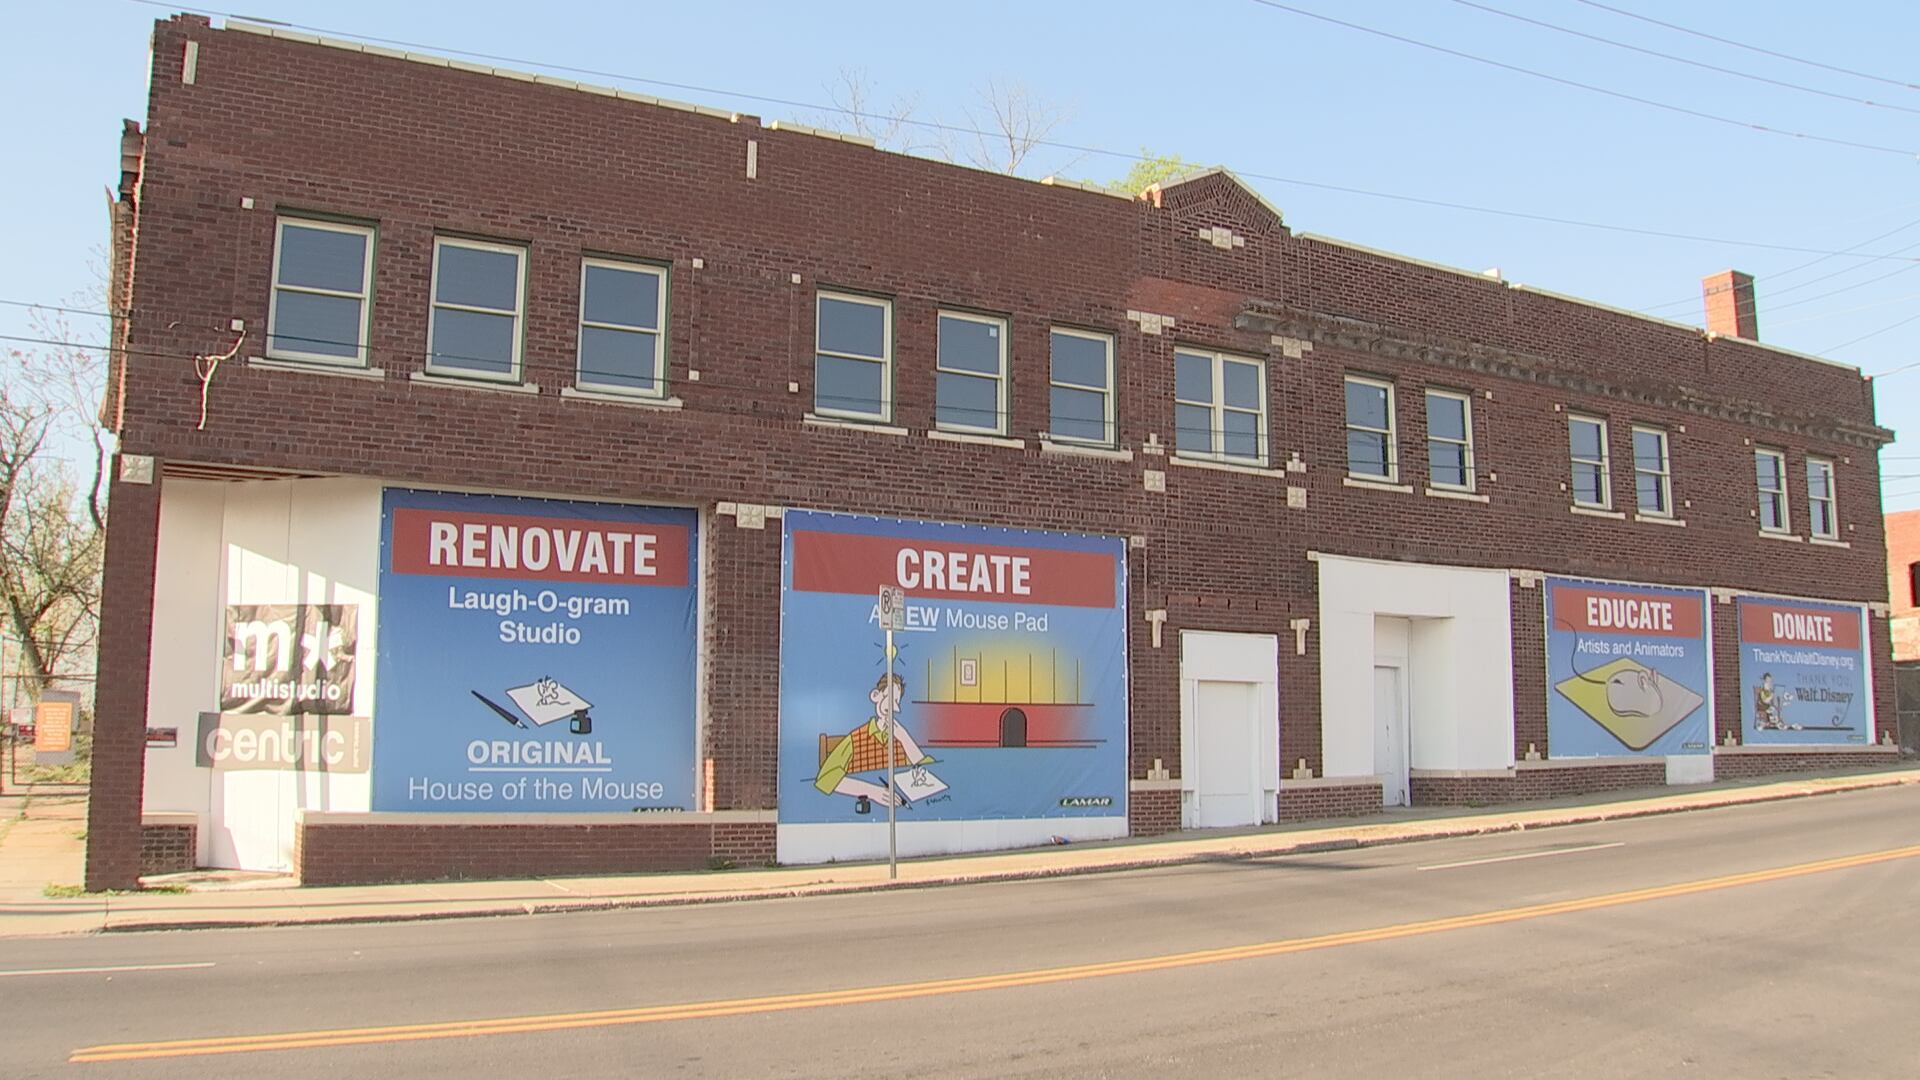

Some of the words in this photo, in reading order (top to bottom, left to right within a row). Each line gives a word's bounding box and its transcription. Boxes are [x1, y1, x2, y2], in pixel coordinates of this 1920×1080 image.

[429, 521, 657, 576] RENOVATE
[897, 548, 1030, 595] CREATE
[449, 586, 630, 618] Laugh-O-gram
[1586, 596, 1673, 631] EDUCATE
[905, 605, 940, 627] EW
[946, 608, 1009, 630] Mouse
[1014, 612, 1048, 632] Pad
[1772, 612, 1834, 642] DONATE
[500, 620, 581, 645] Studio
[1577, 638, 1610, 654] Artists
[1613, 641, 1632, 655] and
[1633, 642, 1684, 658] Animators
[1752, 648, 1854, 670] ThankYouWaltDisney.org
[231, 678, 341, 701] multistudio
[206, 722, 345, 765] centric
[467, 740, 611, 764] ORIGINAL
[408, 777, 493, 800] House
[501, 777, 527, 800] of
[533, 779, 573, 800] the
[582, 777, 664, 800] Mouse
[1062, 798, 1110, 806] LAMAR
